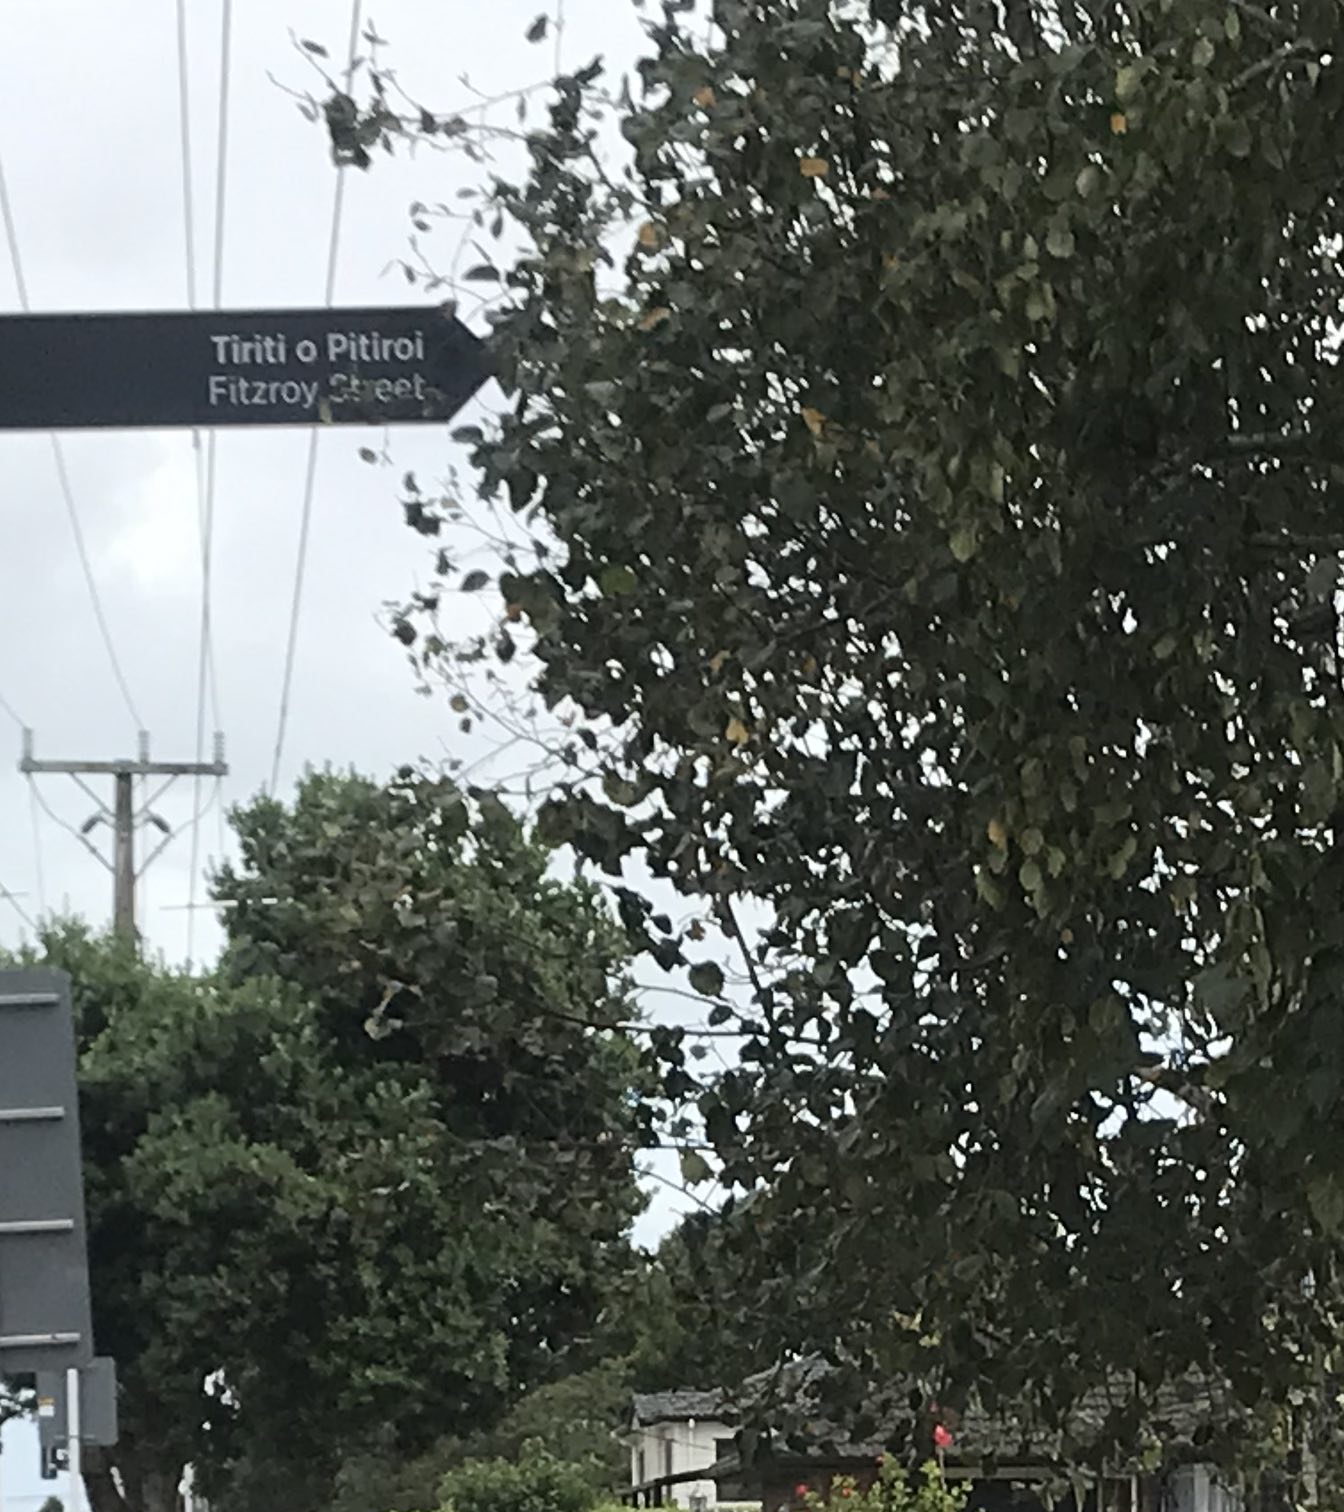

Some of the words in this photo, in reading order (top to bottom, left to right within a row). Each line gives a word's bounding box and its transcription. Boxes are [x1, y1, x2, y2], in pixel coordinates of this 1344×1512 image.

[210, 332, 286, 365] Tiriti
[296, 339, 318, 363] o
[327, 331, 425, 362] Pitiroi
[208, 374, 318, 408] Fitzroy
[328, 372, 426, 403] Steet
